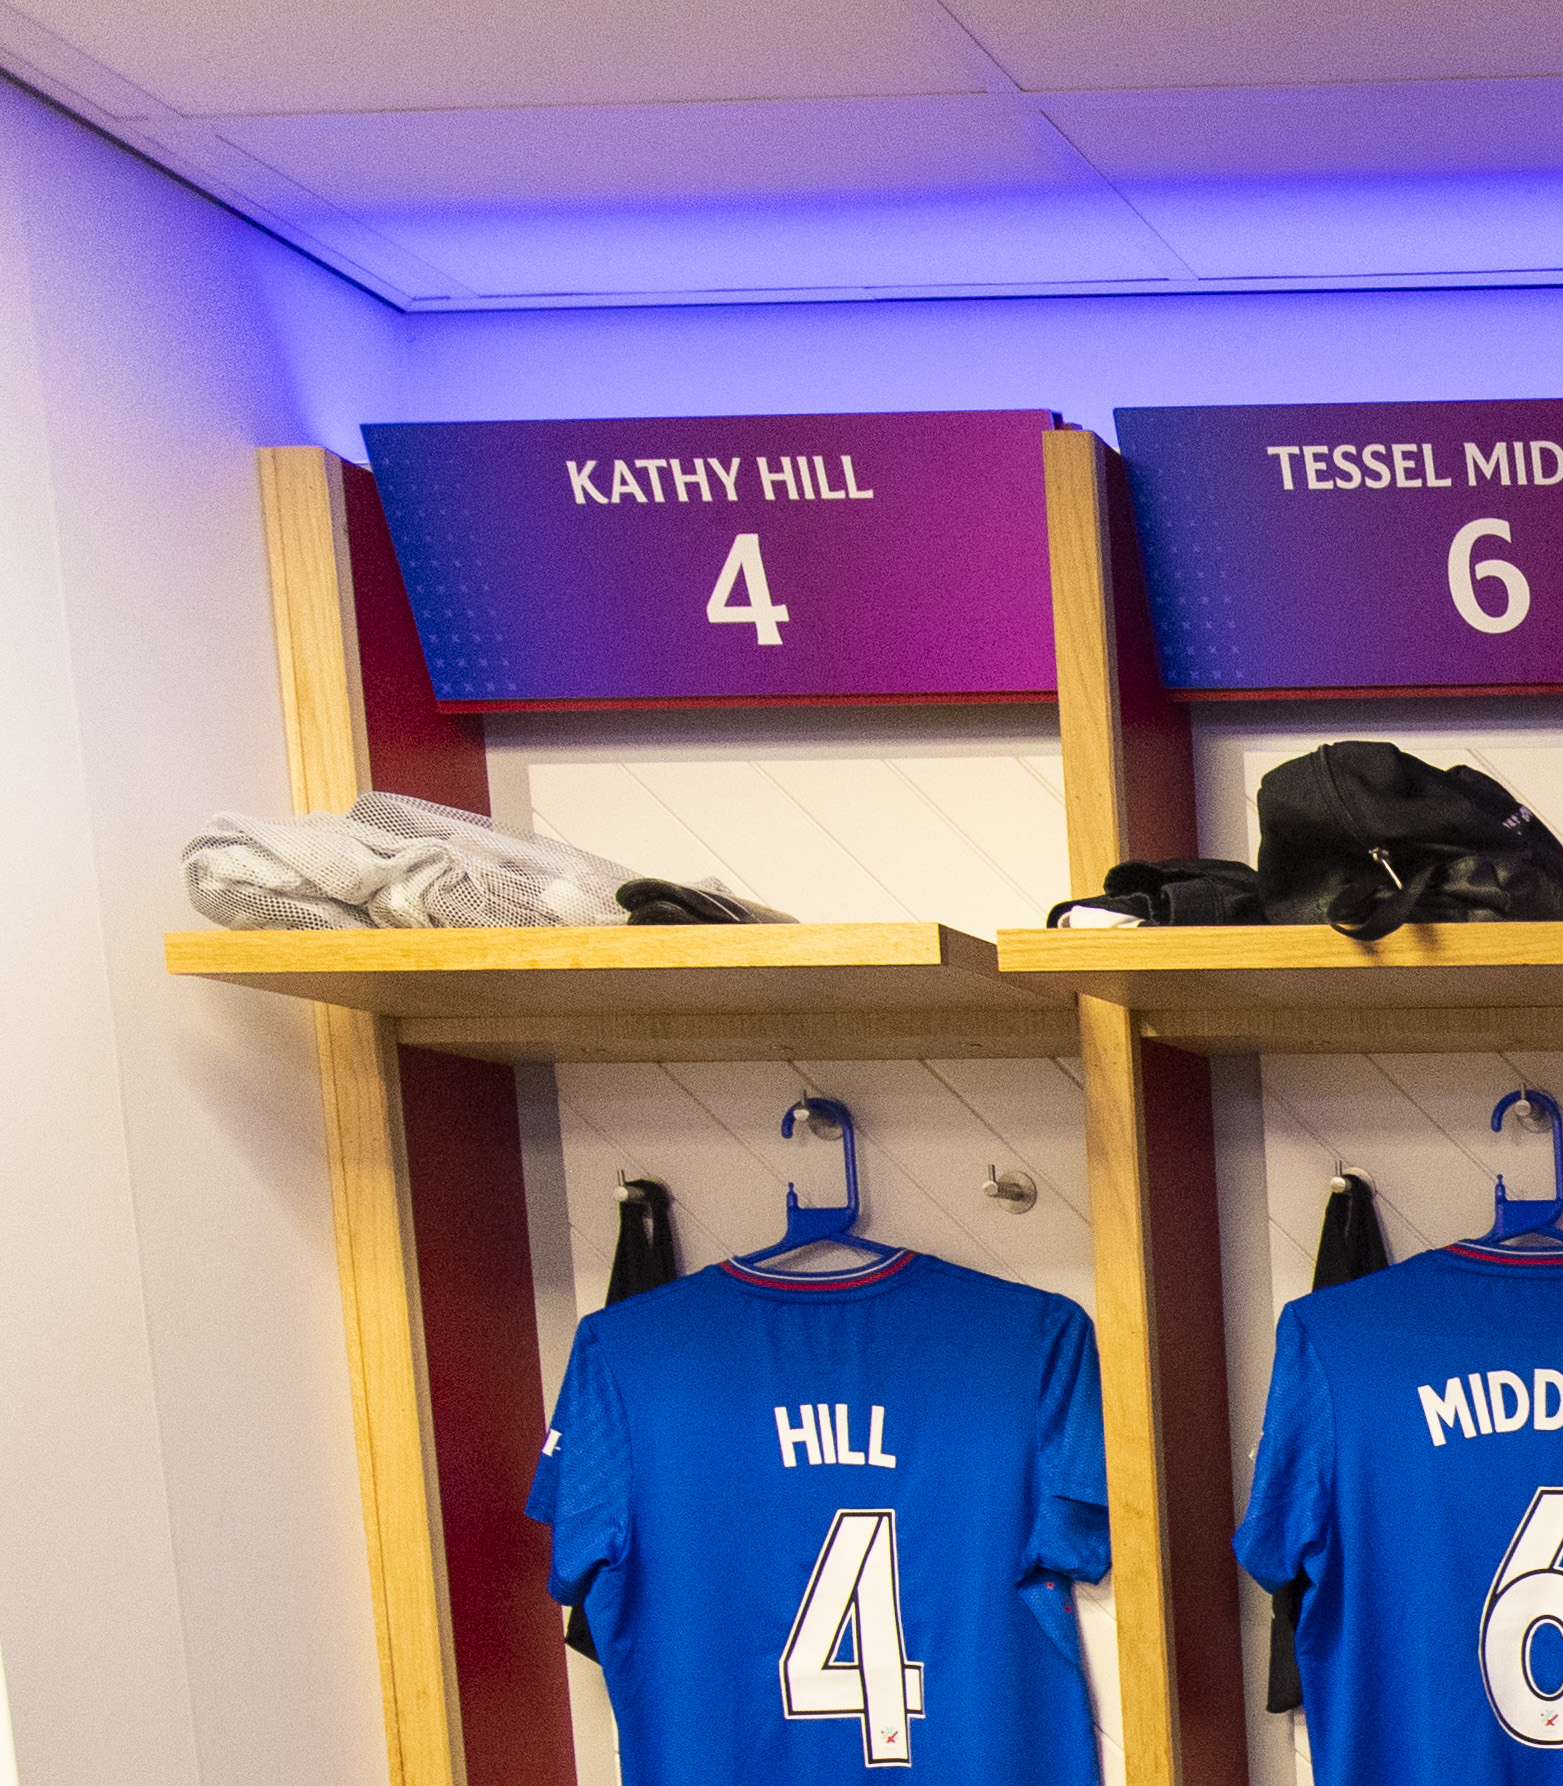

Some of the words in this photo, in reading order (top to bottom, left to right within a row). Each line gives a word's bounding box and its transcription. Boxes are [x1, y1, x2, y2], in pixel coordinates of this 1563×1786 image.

[565, 457, 741, 505] KATHY
[756, 455, 874, 501] HILL
[1266, 442, 1452, 491] TESSEL
[706, 533, 790, 646] 4
[1447, 517, 1531, 634] 6
[773, 1403, 897, 1469] HILL
[778, 1508, 927, 1769] 4
